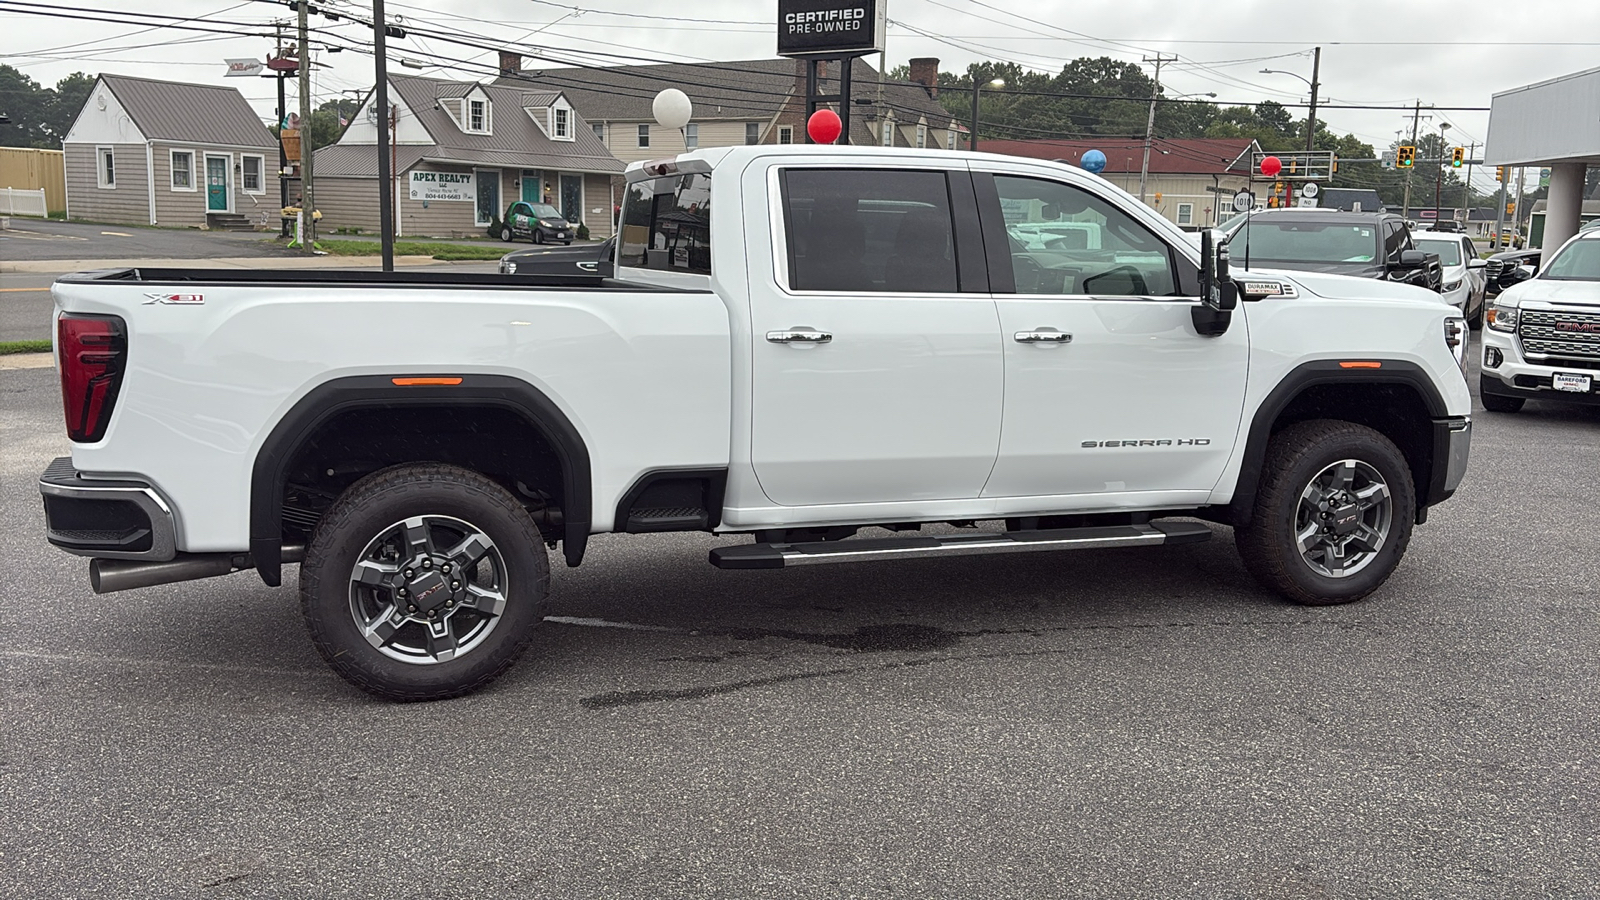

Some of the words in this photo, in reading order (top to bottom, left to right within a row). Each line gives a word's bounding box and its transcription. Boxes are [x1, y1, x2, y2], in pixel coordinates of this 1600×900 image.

[785, 8, 865, 24] CERTIFIED
[788, 20, 860, 34] PRE-OWNED
[413, 172, 437, 182] APEX
[438, 173, 471, 184] REALTY
[1557, 376, 1588, 384] BAREFORD
[1081, 439, 1172, 448] SIERRA
[1177, 438, 1211, 446] HD
